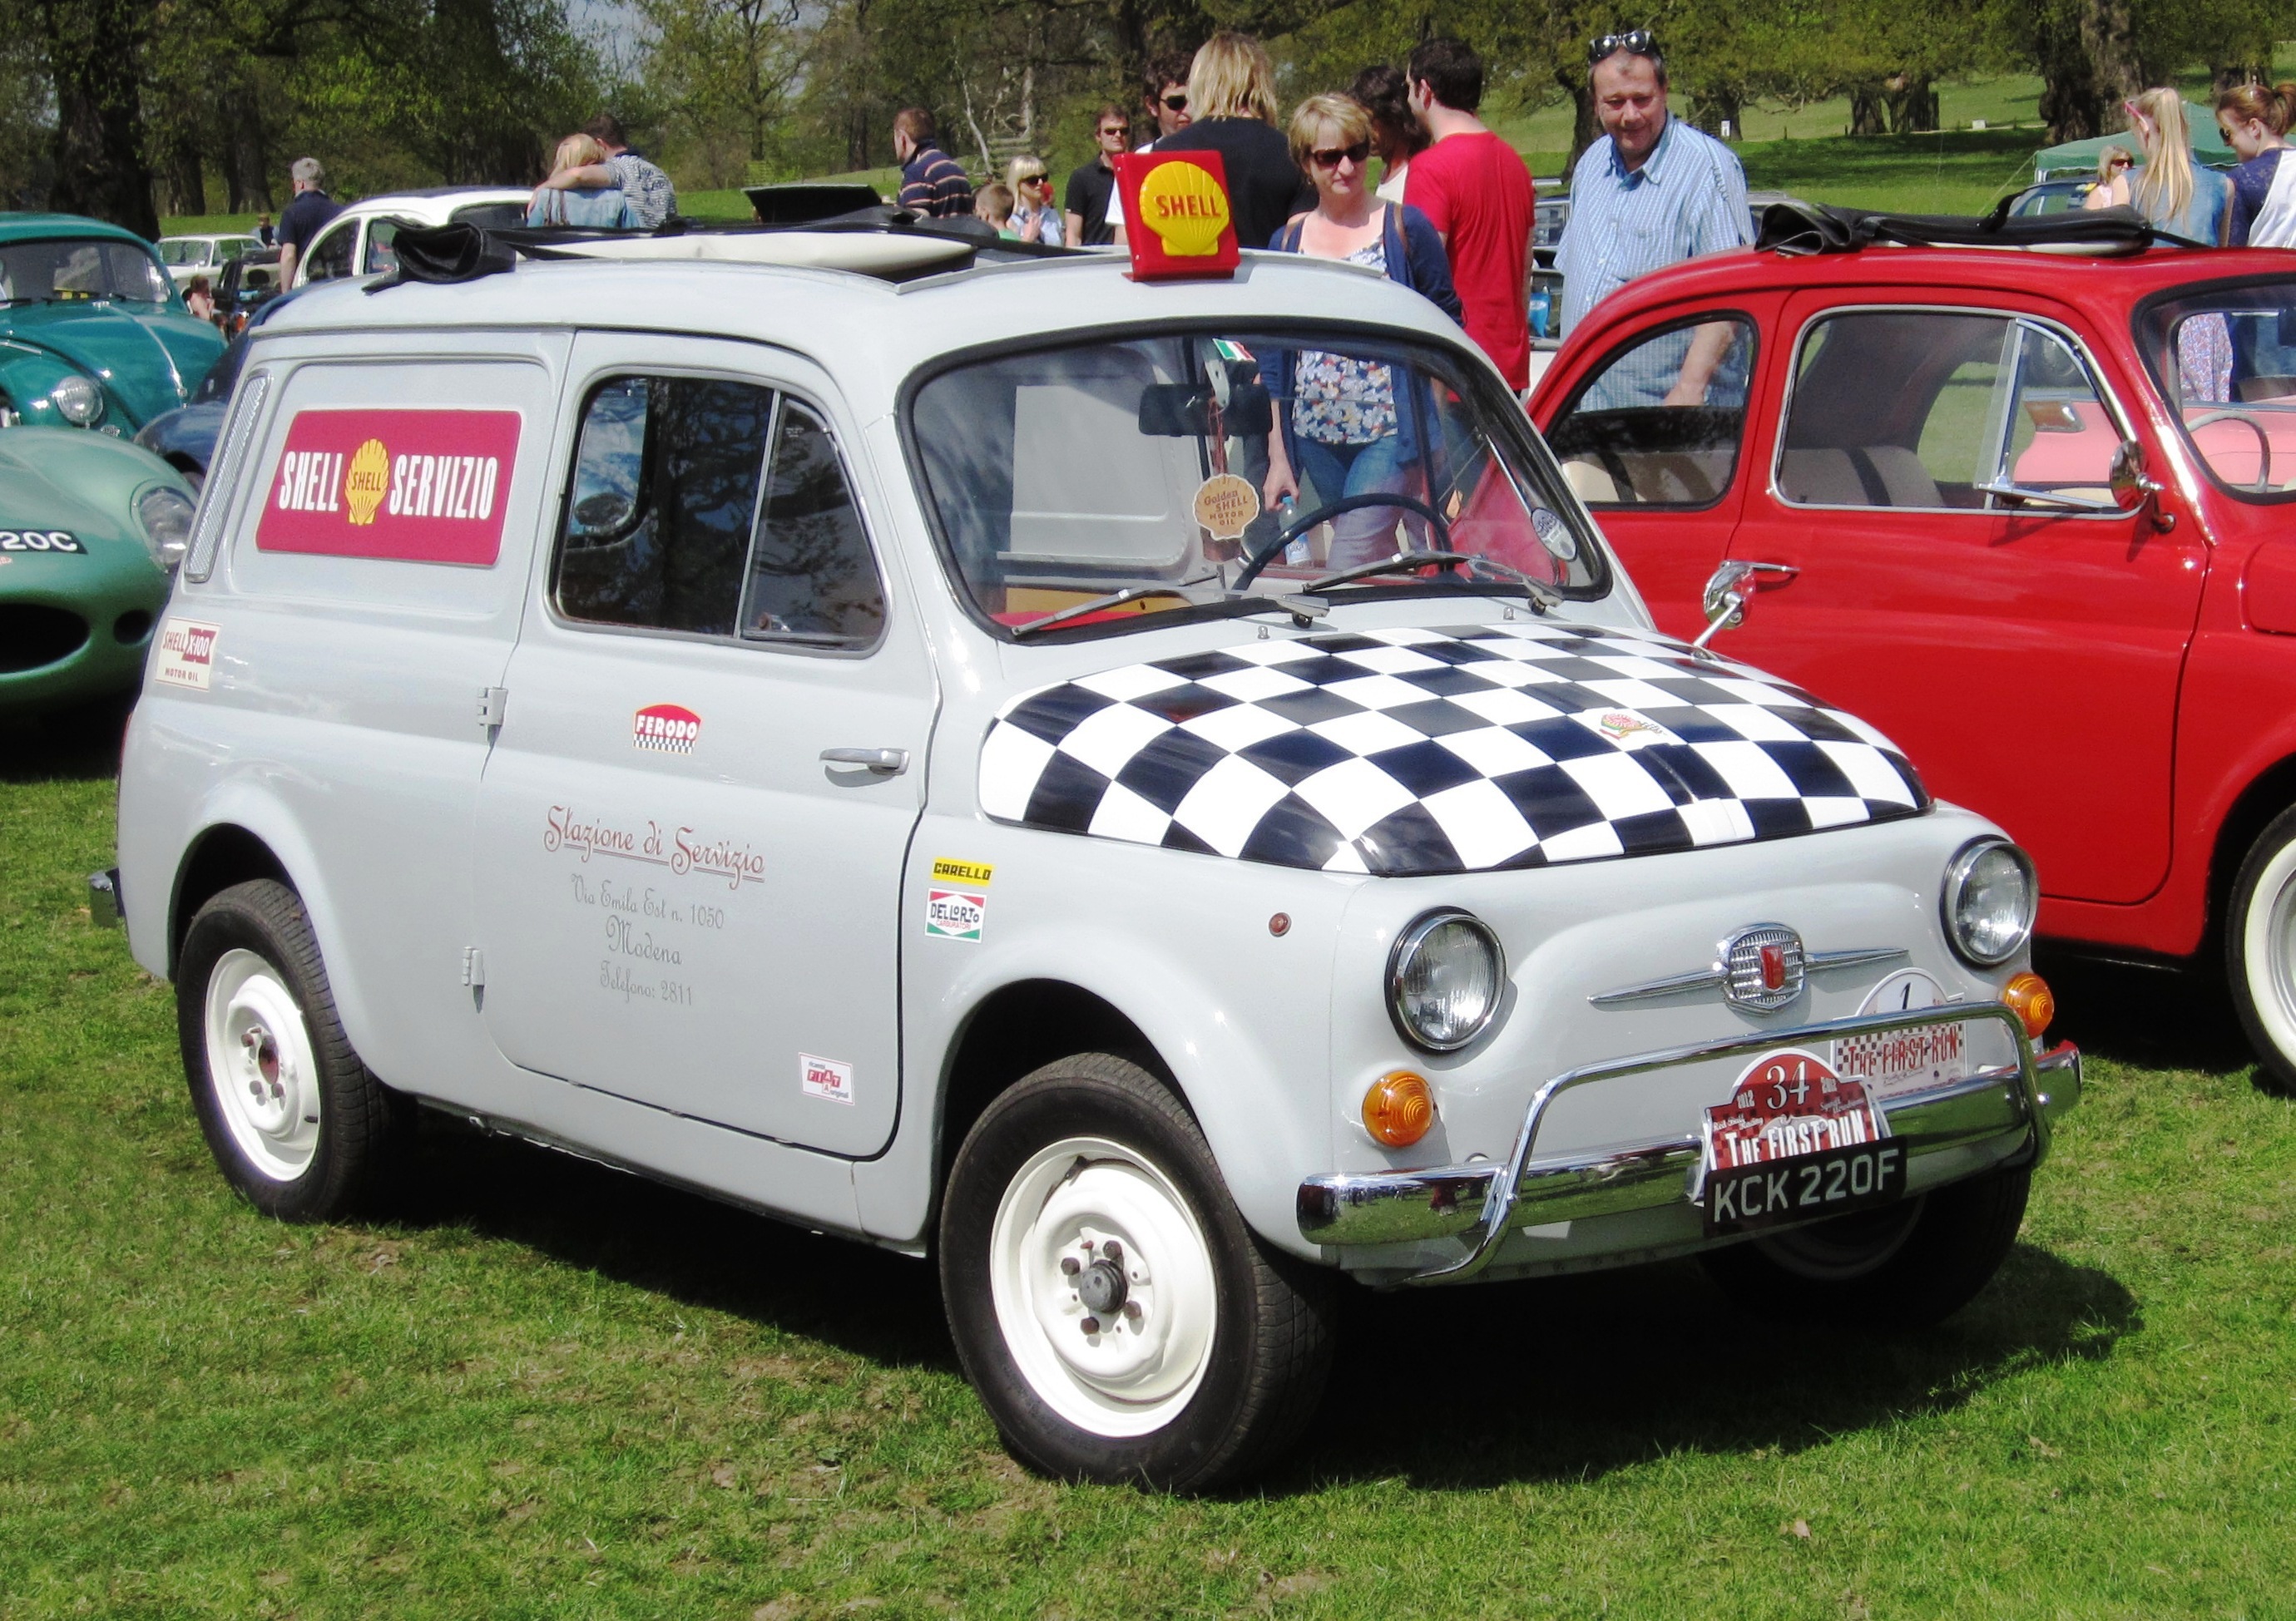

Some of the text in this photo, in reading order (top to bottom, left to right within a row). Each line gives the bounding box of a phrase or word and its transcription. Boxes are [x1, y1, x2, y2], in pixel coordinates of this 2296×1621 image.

[1155, 194, 1221, 220] SHELL
[279, 451, 497, 520] SHELL SERVIZIO
[351, 471, 382, 492] SHELL
[1204, 490, 1238, 506] Golden
[1215, 496, 1248, 512] SHELL
[1210, 510, 1244, 520] MOTOR
[162, 630, 210, 658] SHELL X-100
[166, 667, 199, 682] MOTOR OIL
[636, 714, 698, 740] FERODO
[544, 805, 765, 890] Stazione di Servizio
[933, 862, 992, 881] CARELLO
[572, 873, 596, 905] Via
[644, 887, 666, 919] Est
[691, 904, 725, 929] 1050
[606, 915, 682, 965] Modena
[661, 980, 691, 1006] 2811
[1848, 1025, 1959, 1076] THE FIRST RUN
[808, 1069, 841, 1088] FIAT
[1766, 1060, 1810, 1110] 34
[1724, 1109, 1867, 1168] THE FIRST RUN
[1714, 1147, 1900, 1223] KCK 220F
